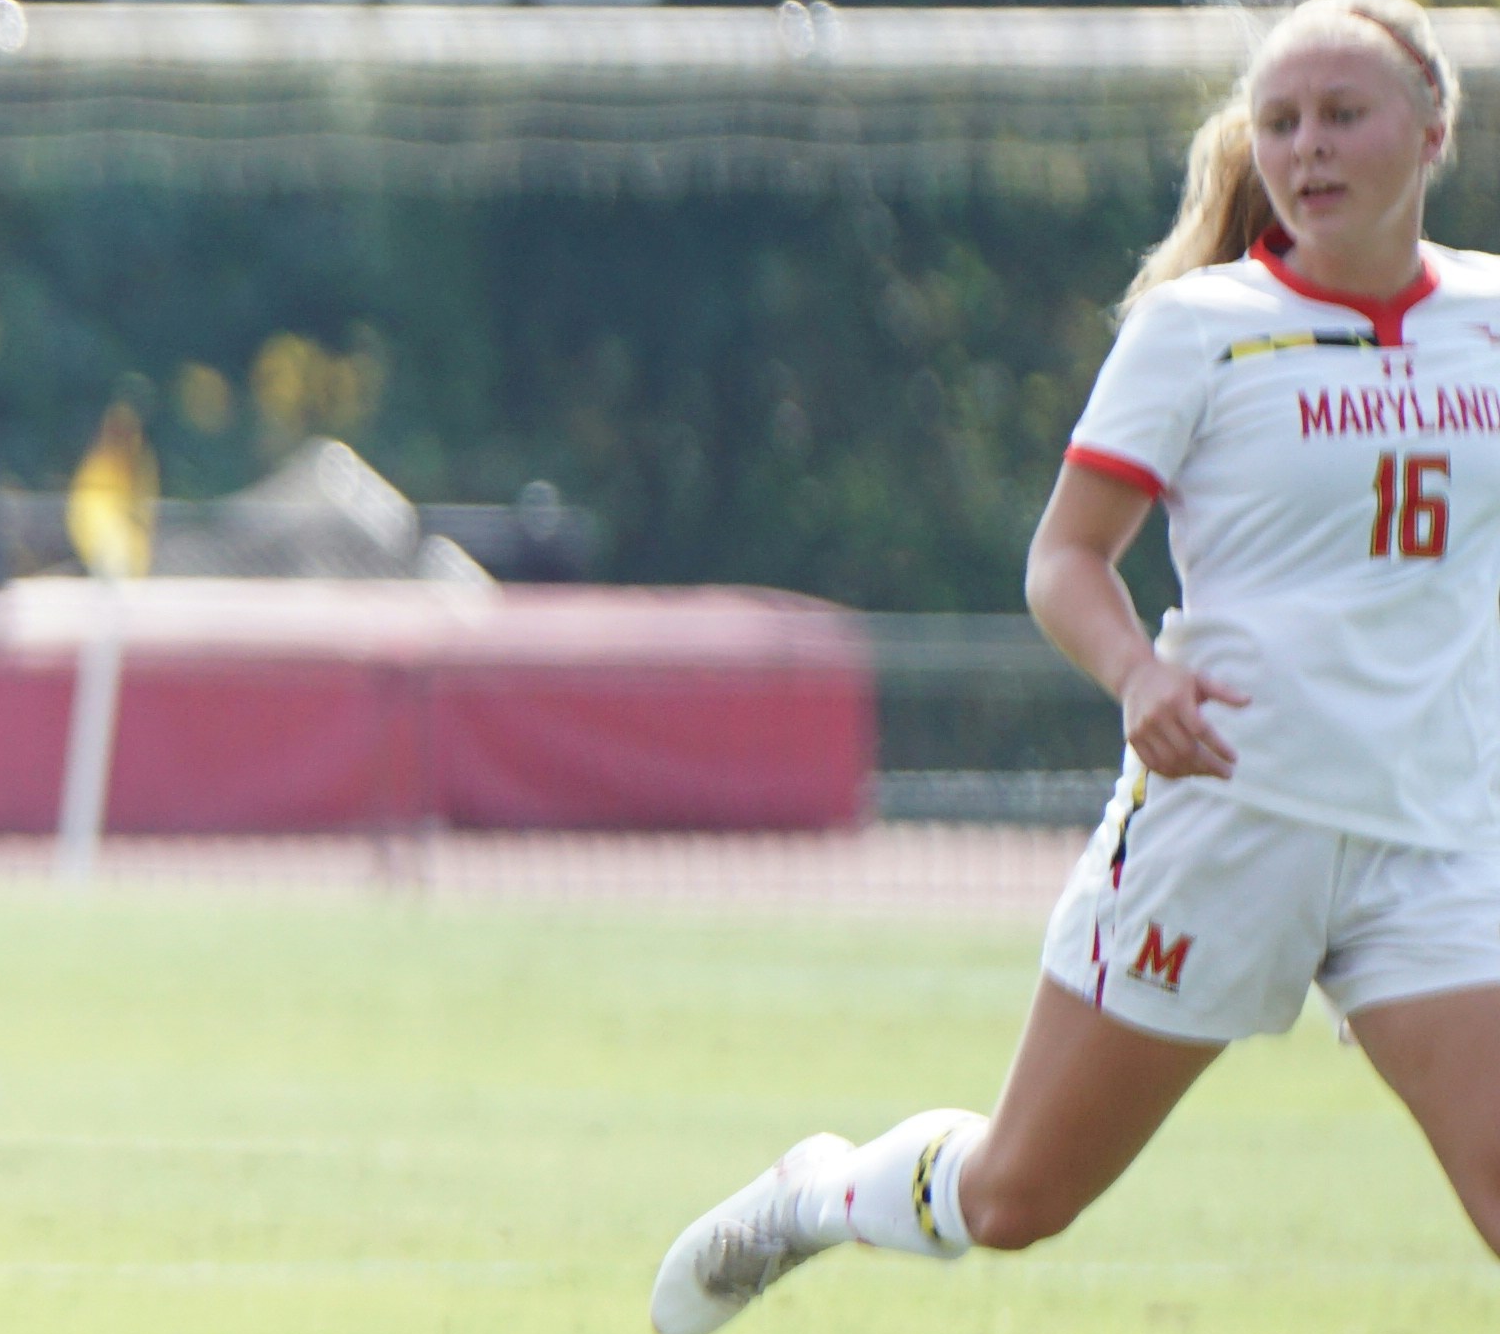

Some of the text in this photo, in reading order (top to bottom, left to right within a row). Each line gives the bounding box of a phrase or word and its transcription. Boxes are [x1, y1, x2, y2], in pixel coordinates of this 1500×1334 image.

[1298, 385, 1500, 439] MARYLAND
[1370, 449, 1451, 557] 16
[1129, 921, 1194, 995] M
